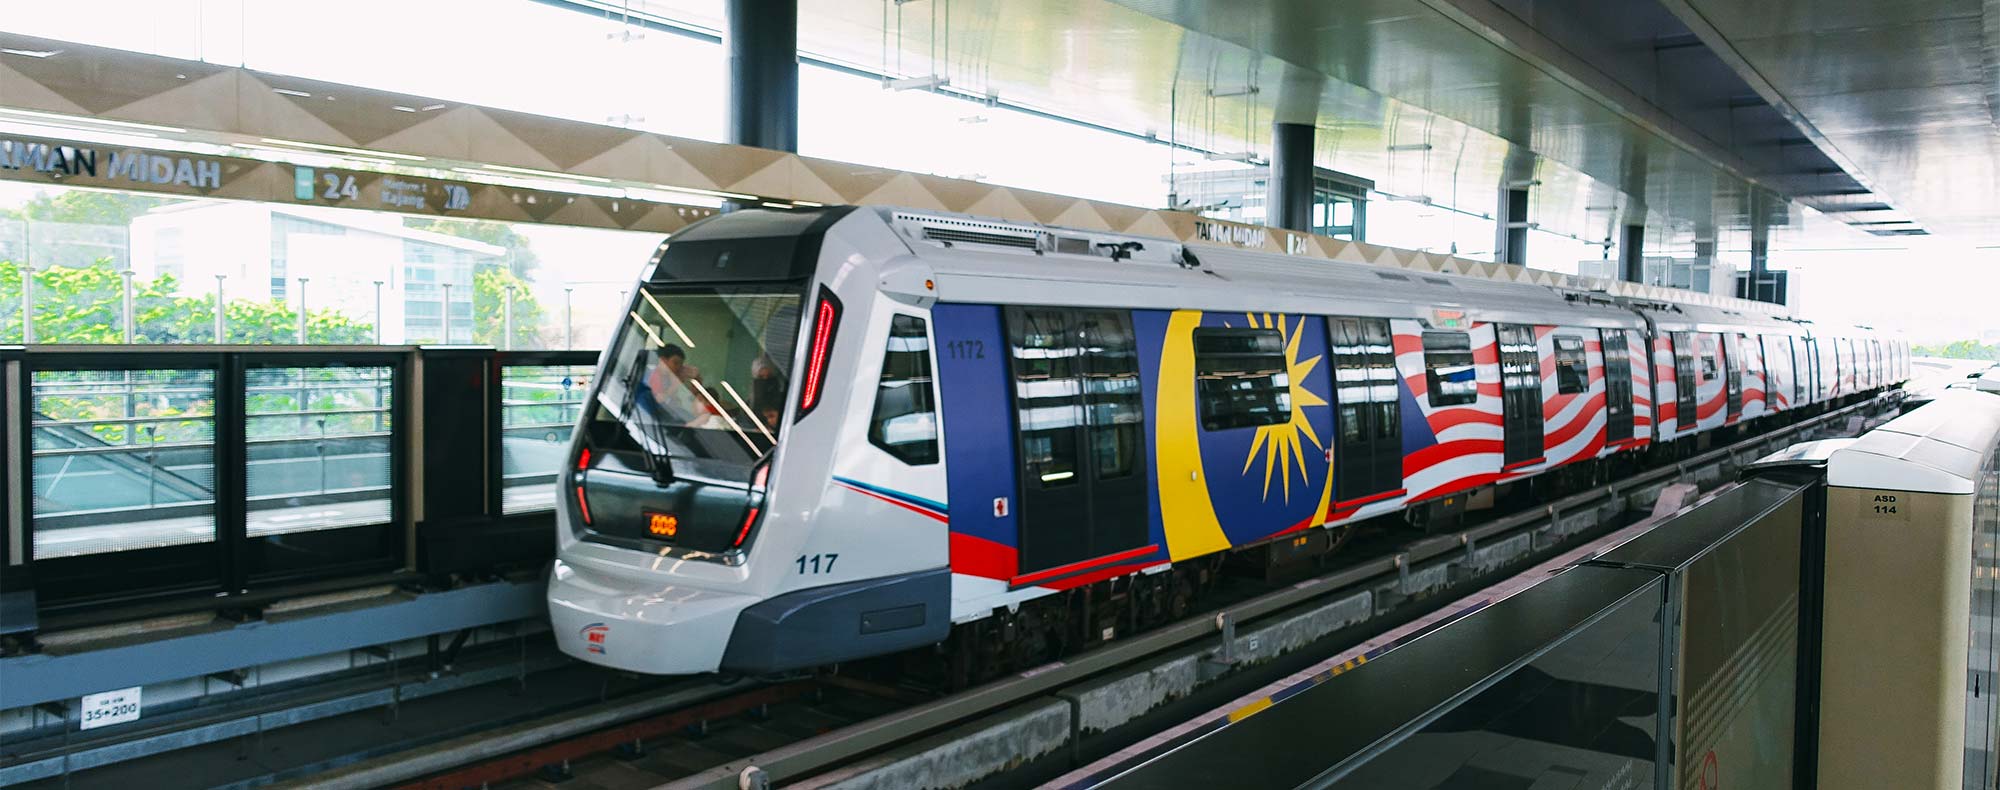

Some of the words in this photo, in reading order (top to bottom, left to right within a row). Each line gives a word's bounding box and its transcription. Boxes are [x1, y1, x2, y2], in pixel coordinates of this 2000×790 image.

[107, 151, 221, 188] MIDAH
[322, 173, 359, 201] 24
[1295, 237, 1307, 254] 24
[947, 340, 985, 360] 1172
[1874, 505, 1897, 514] 114
[796, 553, 839, 575] 117
